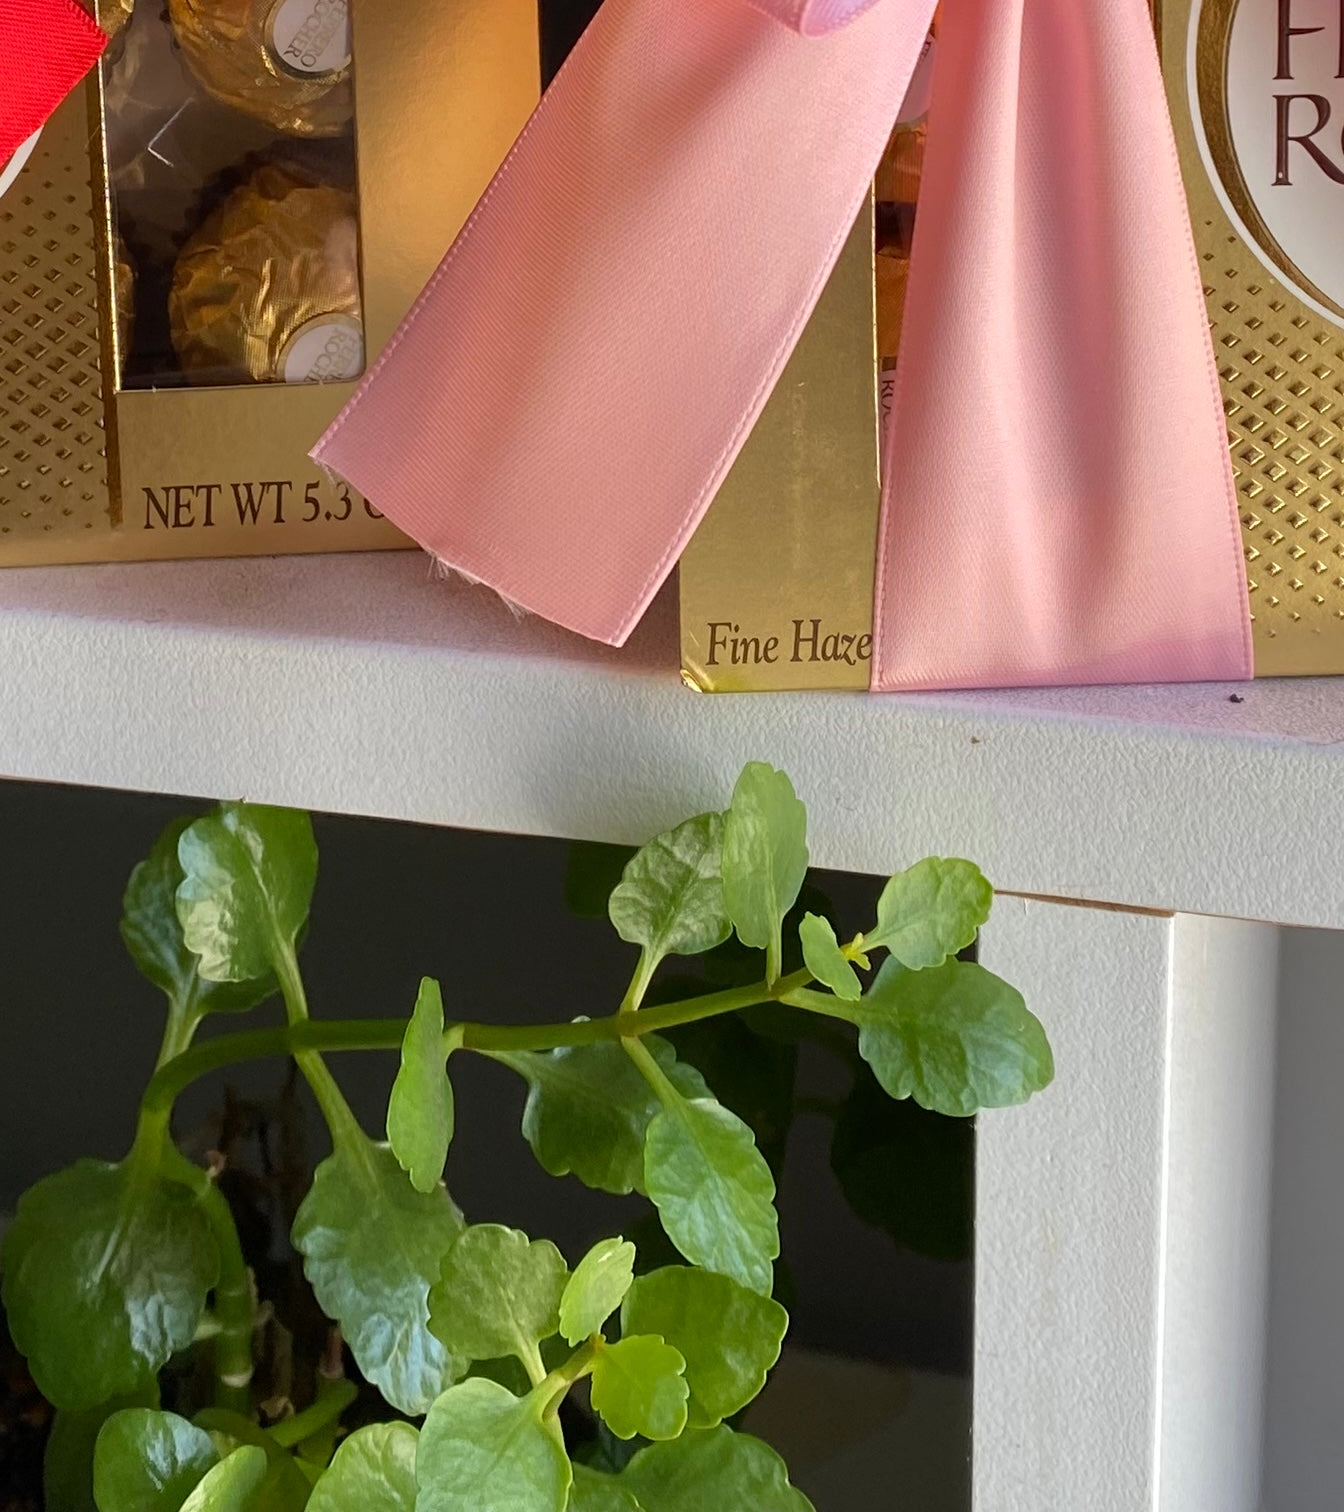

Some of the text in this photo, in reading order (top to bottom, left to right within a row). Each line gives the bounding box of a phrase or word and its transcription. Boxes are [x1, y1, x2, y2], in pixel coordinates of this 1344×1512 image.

[142, 484, 222, 529] NET
[230, 481, 292, 525] WT
[302, 480, 352, 522] 5.3
[706, 619, 873, 666] Fine Haze
